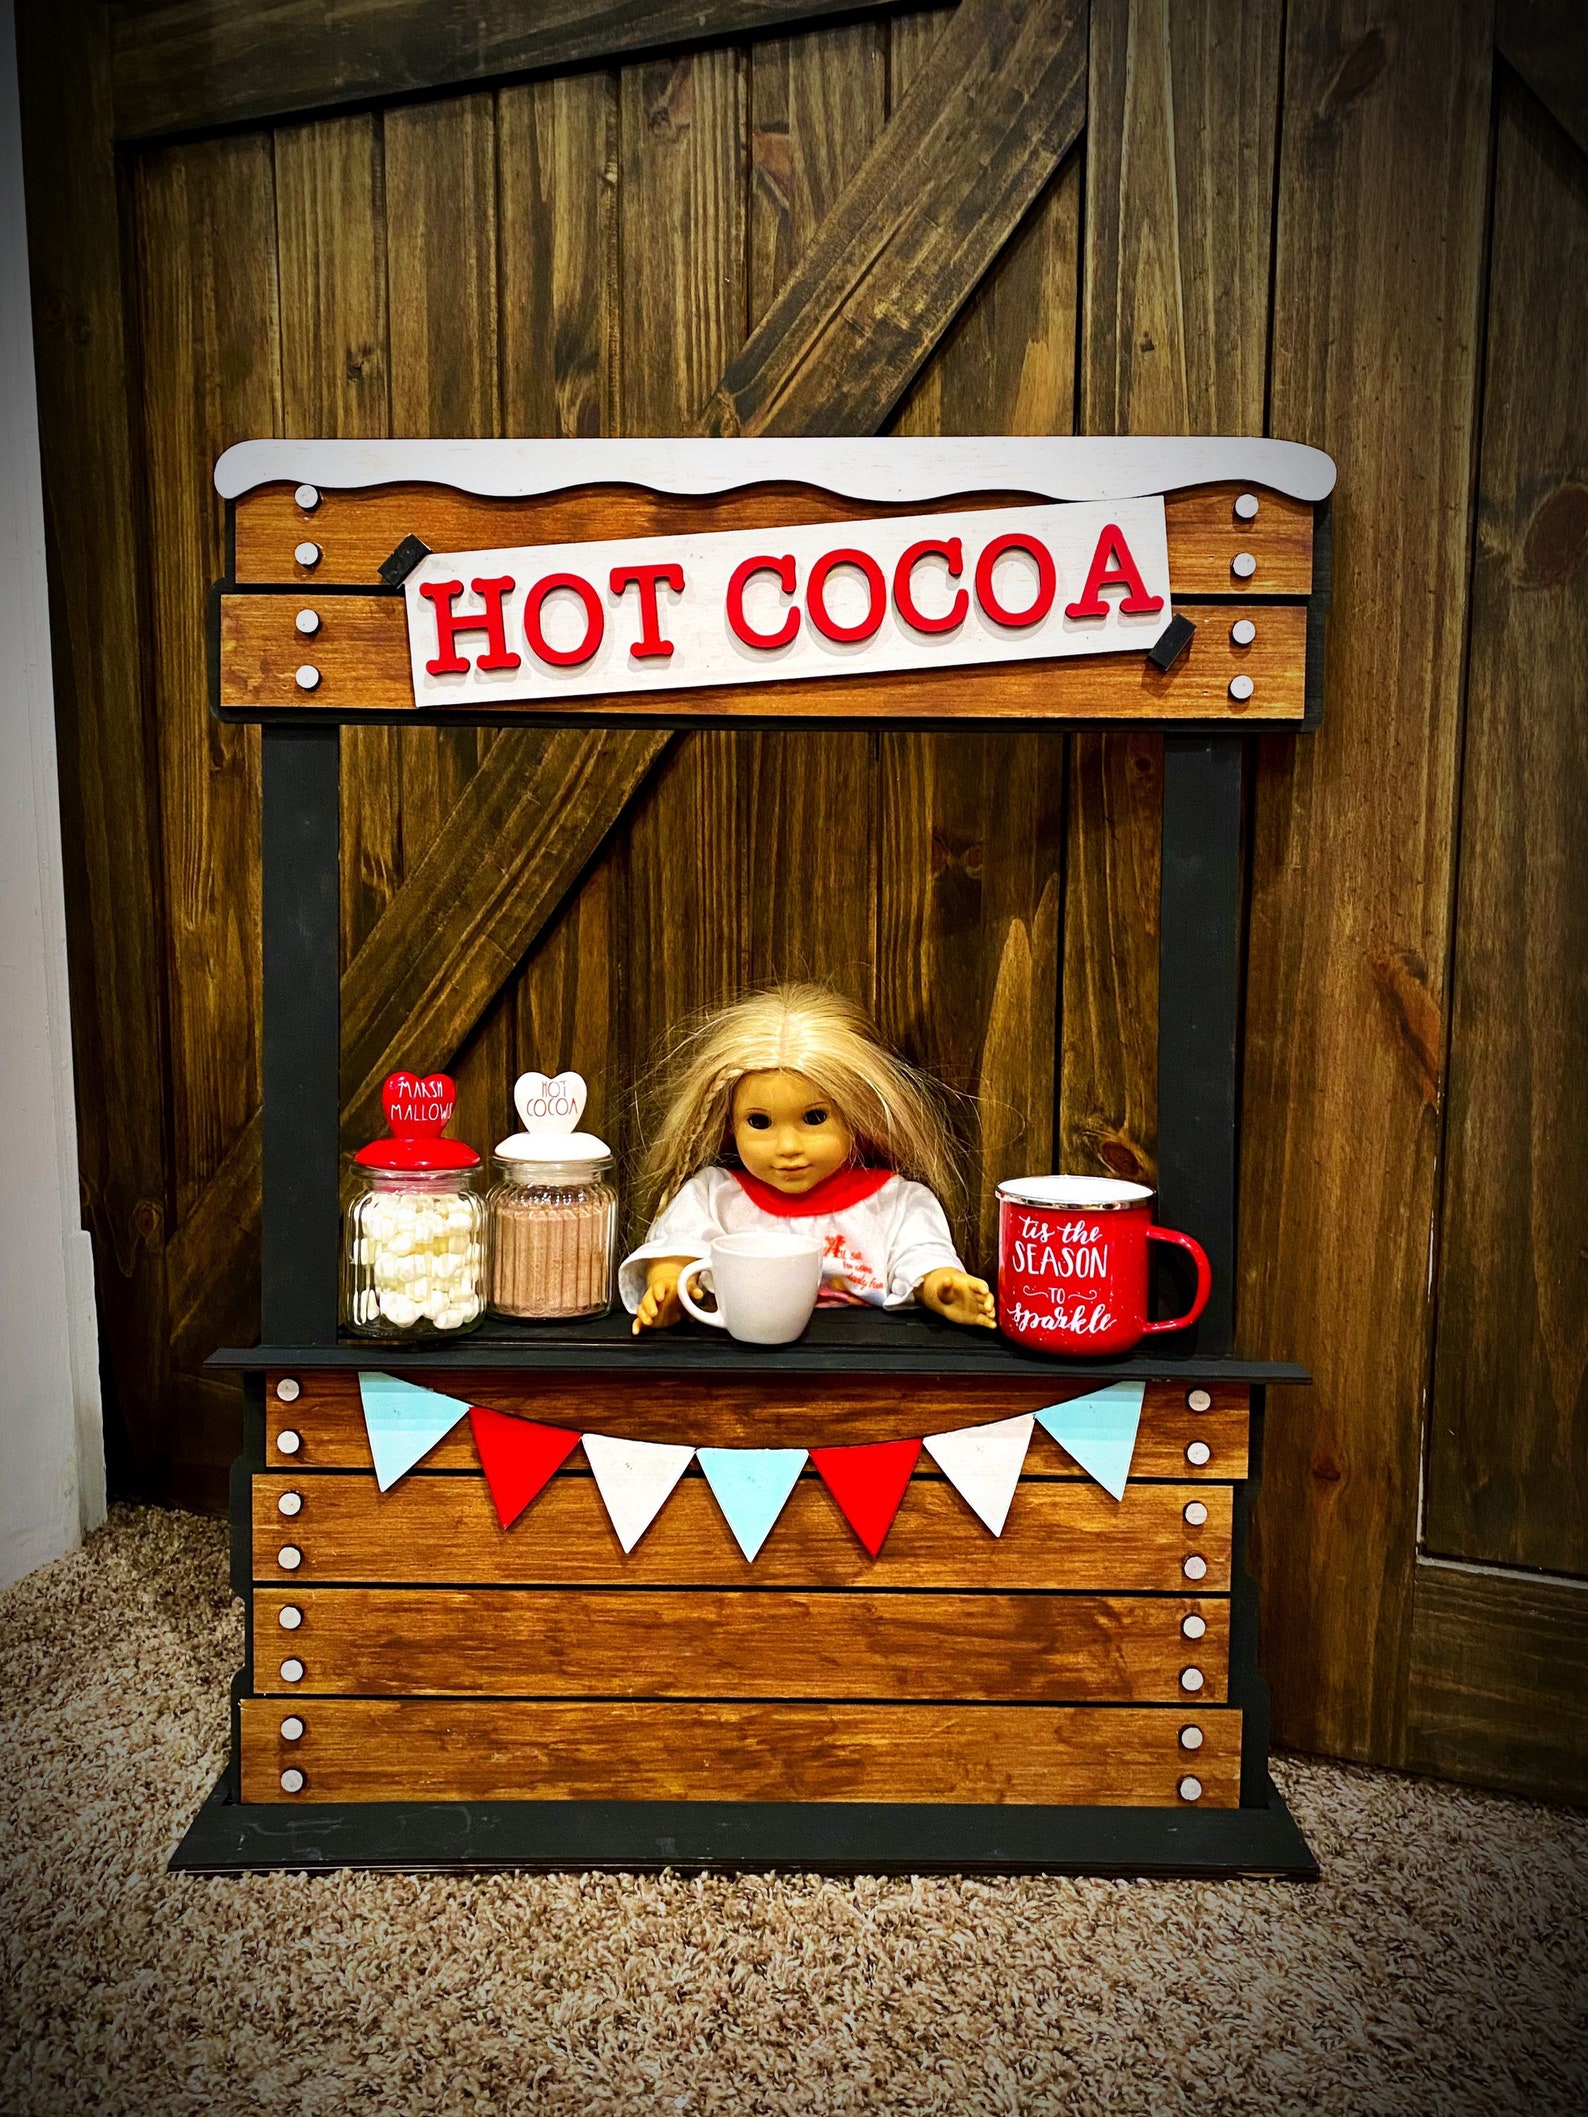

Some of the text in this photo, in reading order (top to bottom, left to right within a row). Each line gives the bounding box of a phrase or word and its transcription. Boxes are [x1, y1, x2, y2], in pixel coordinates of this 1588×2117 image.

[420, 523, 1165, 677] HOT COCOA
[398, 1080, 443, 1099] MARSH
[541, 1080, 568, 1098] HOT
[391, 1102, 454, 1122] MALLOWS
[526, 1097, 579, 1118] COCOA
[1056, 1220, 1103, 1245] the
[1012, 1240, 1109, 1279] SEASON
[1048, 1287, 1066, 1304] TO
[1007, 1302, 1117, 1335] sparkle
